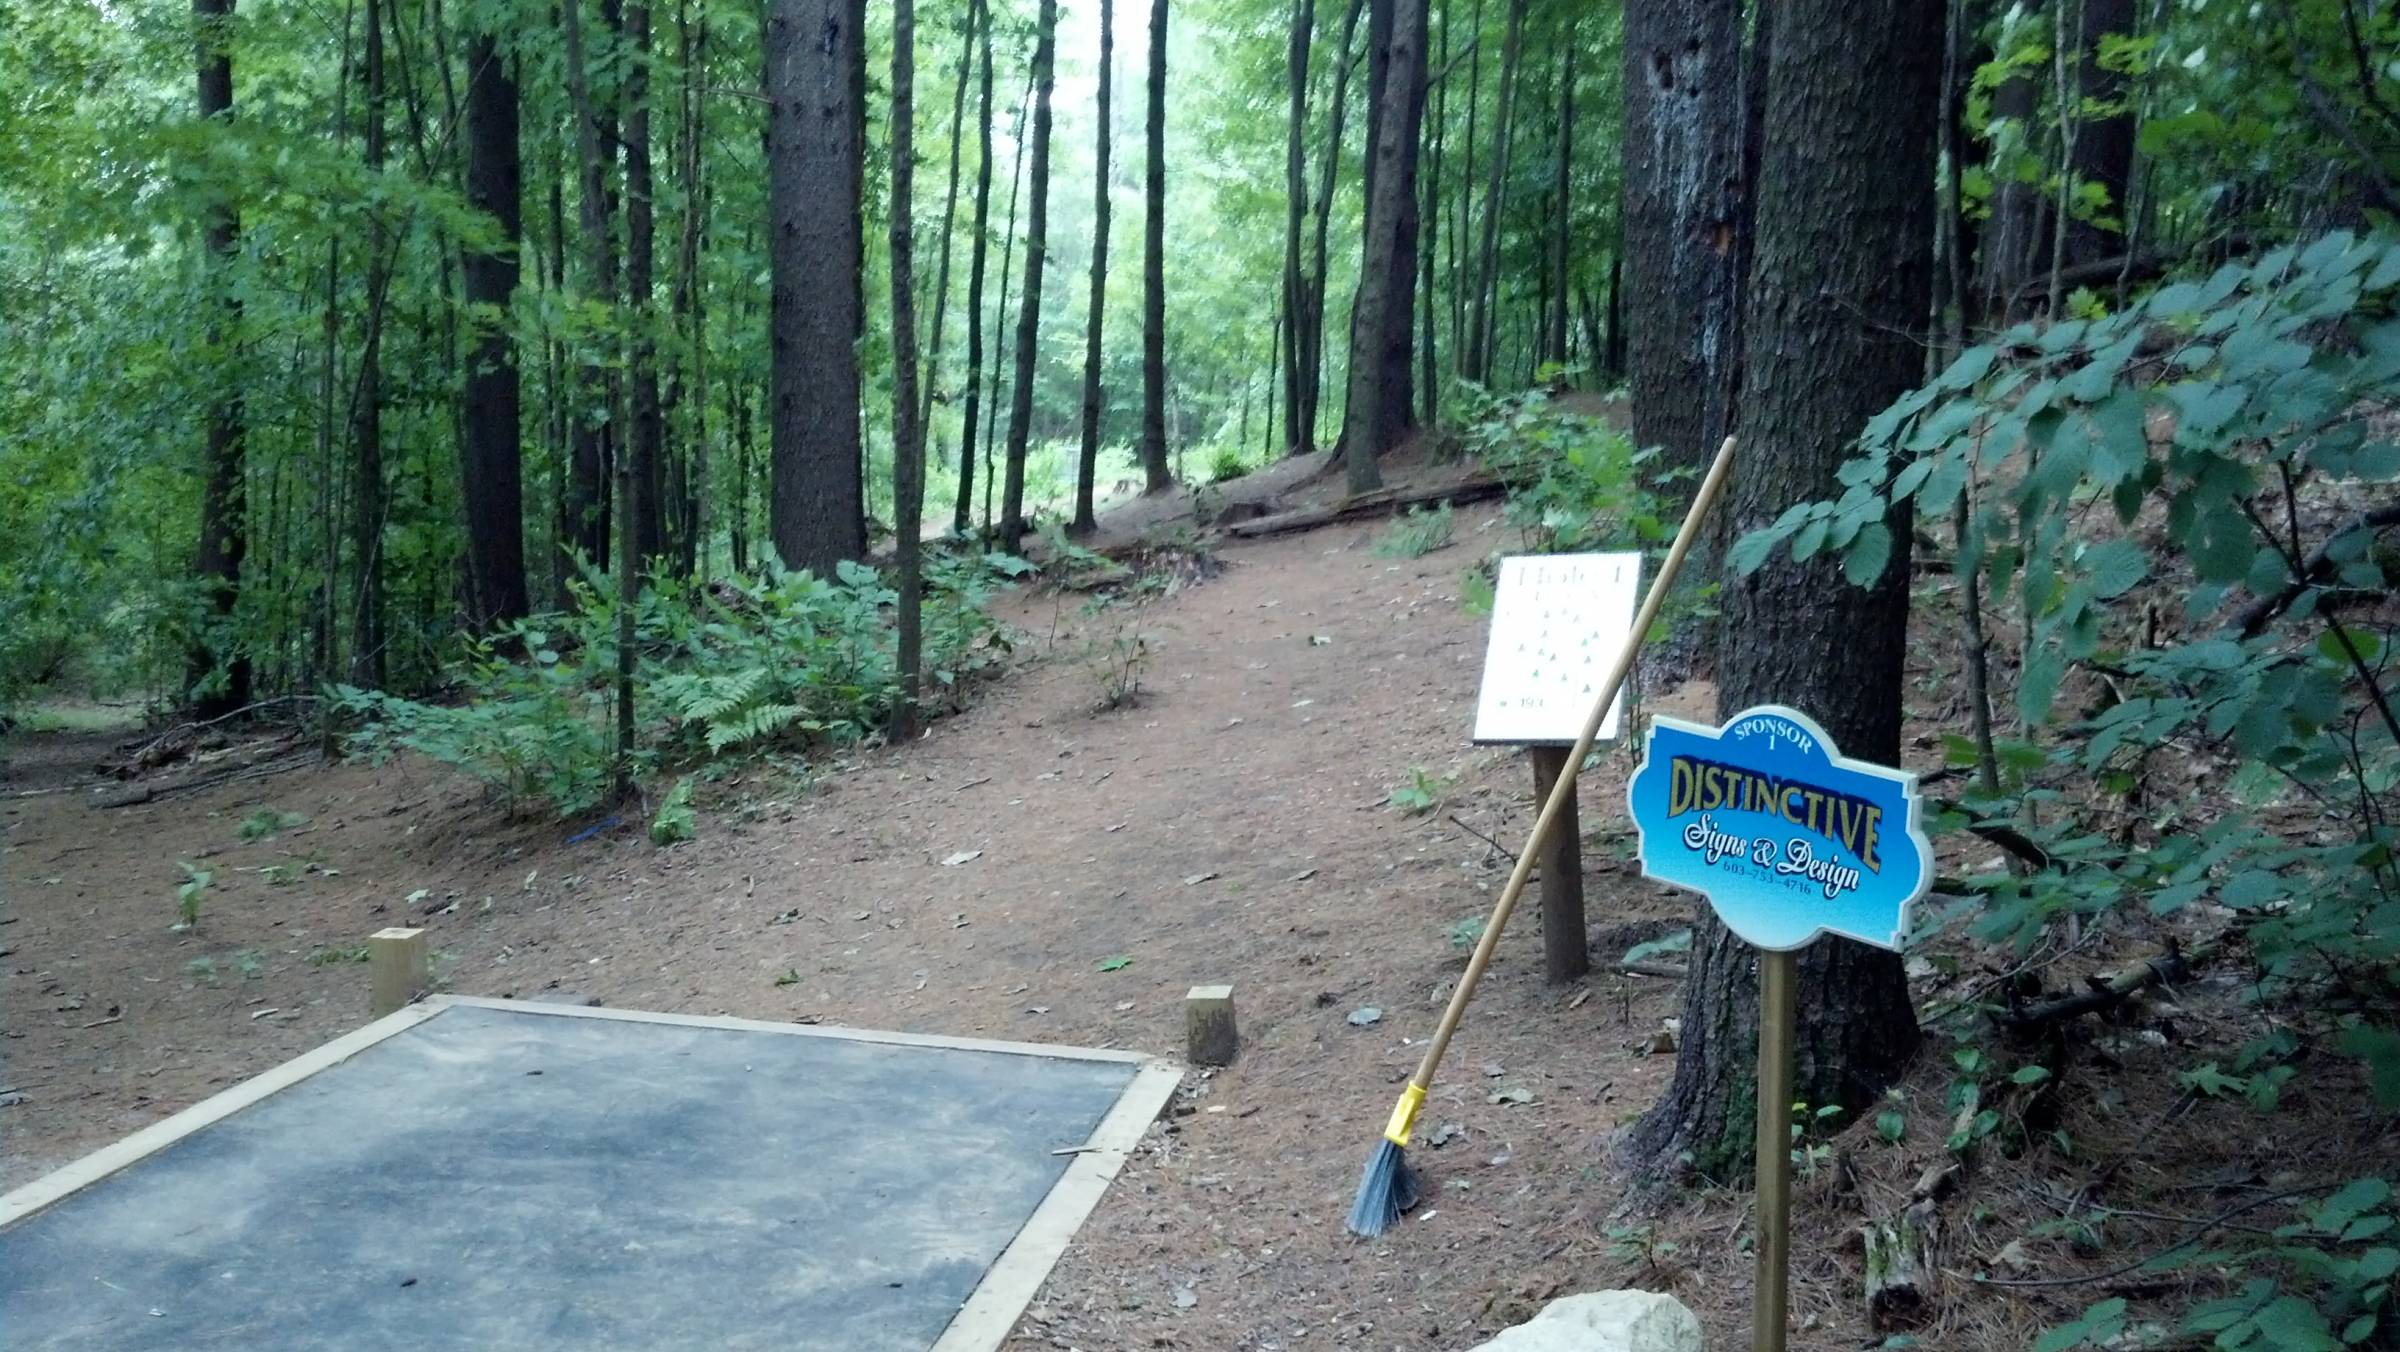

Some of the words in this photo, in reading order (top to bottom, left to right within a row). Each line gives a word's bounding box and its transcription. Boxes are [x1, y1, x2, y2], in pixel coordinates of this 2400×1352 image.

[1734, 719, 1812, 755] SPONSOR
[1769, 734, 1775, 751] 1
[1667, 756, 1882, 874] DISTINCTIVE
[1684, 813, 1747, 865] Signs
[1752, 837, 1777, 867] &
[1775, 837, 1860, 899] Design
